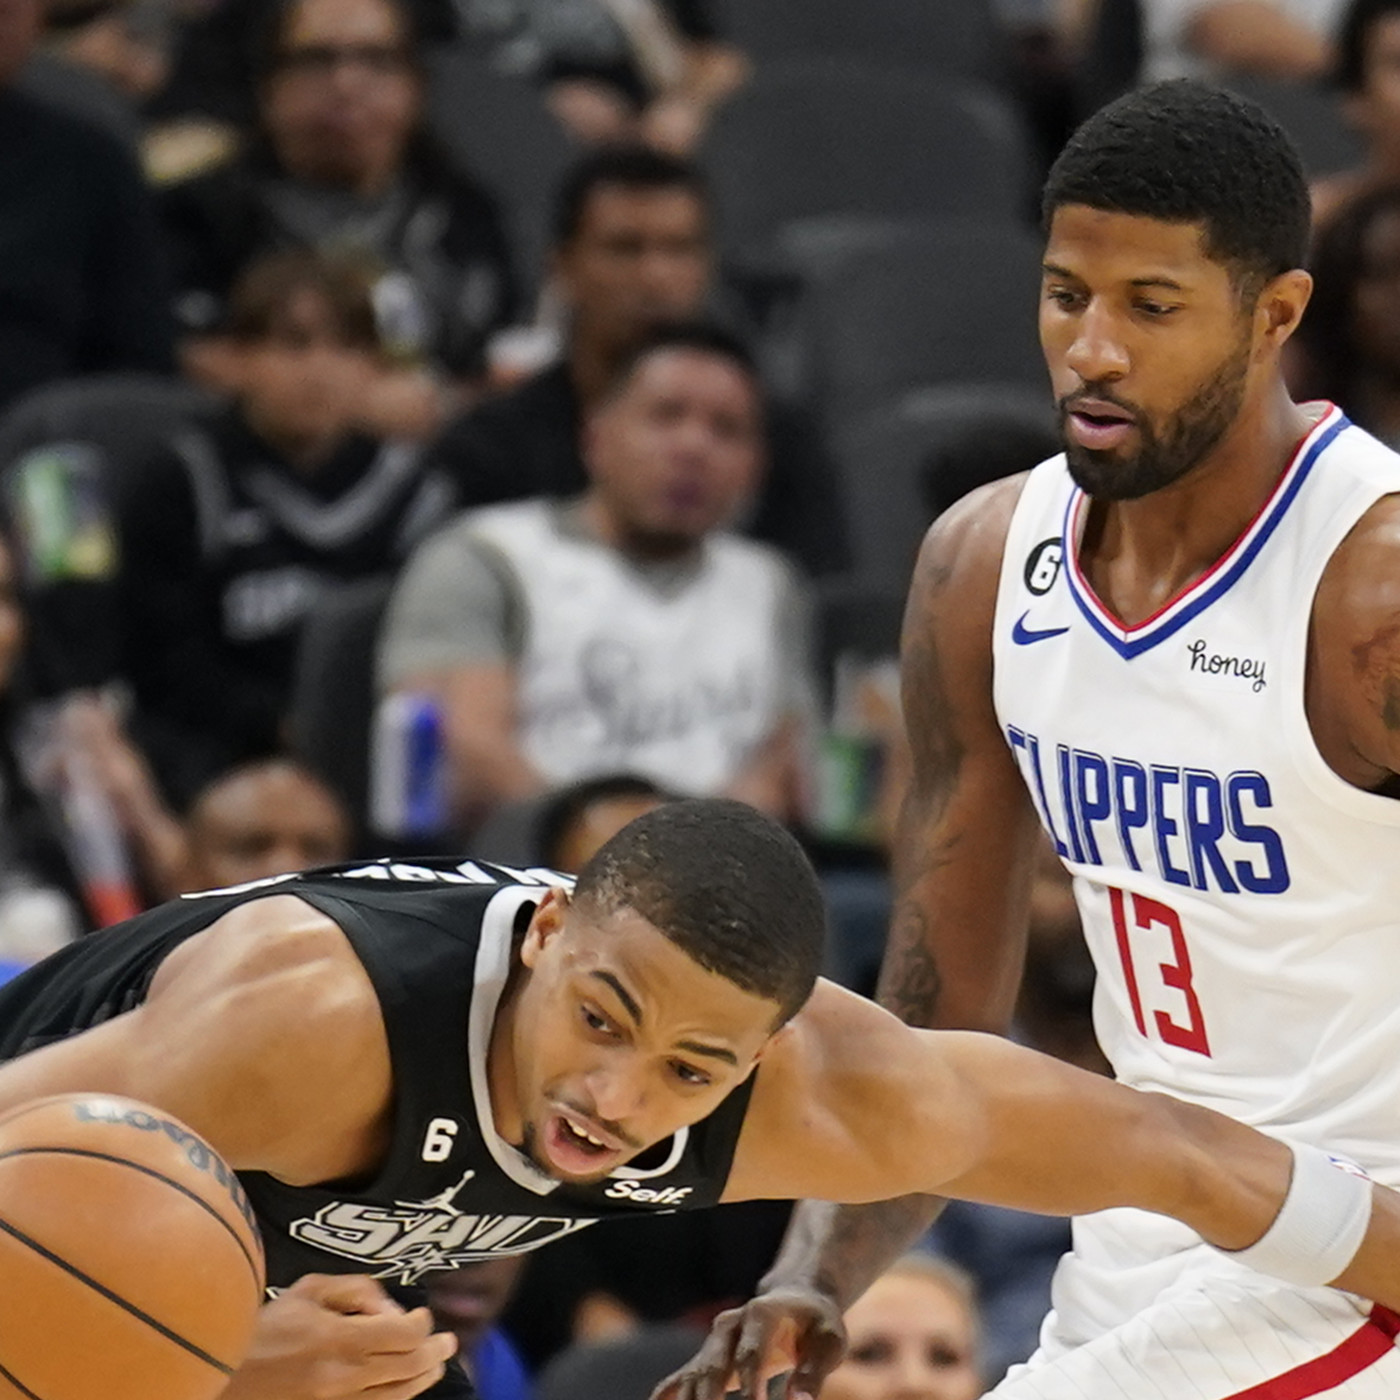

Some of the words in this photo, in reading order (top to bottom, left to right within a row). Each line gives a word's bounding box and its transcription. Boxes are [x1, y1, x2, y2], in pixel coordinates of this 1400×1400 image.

[1028, 542, 1062, 591] 6
[1187, 639, 1267, 693] honey
[1107, 885, 1212, 1059] 13
[421, 1117, 459, 1163] 6
